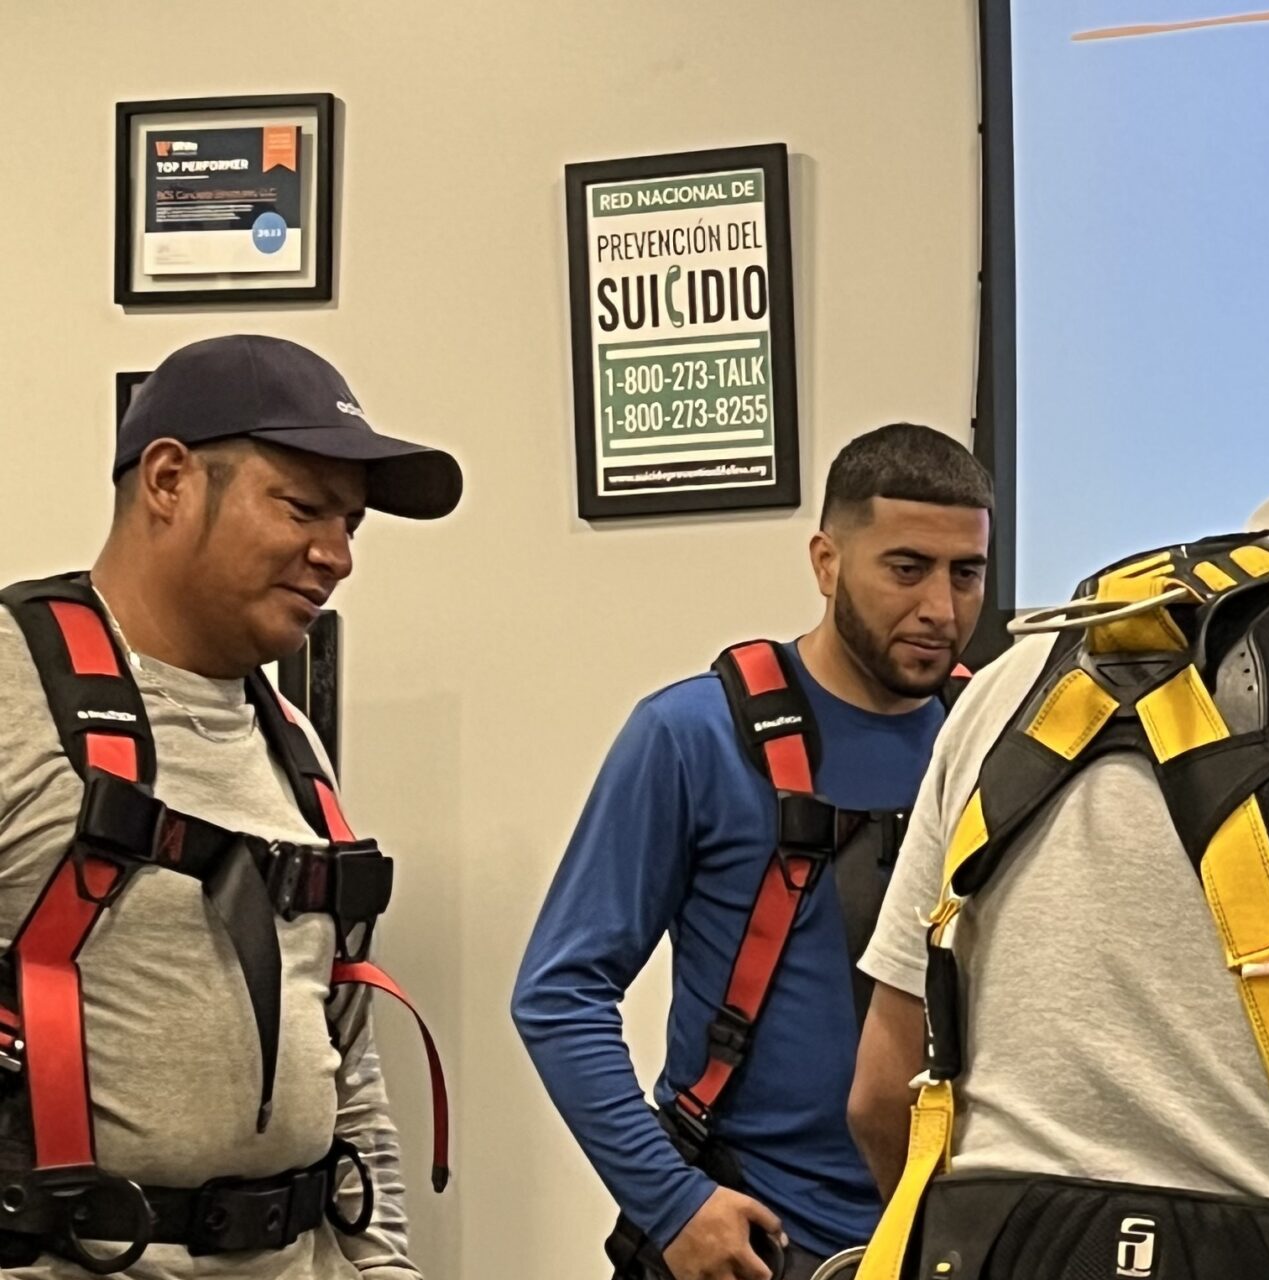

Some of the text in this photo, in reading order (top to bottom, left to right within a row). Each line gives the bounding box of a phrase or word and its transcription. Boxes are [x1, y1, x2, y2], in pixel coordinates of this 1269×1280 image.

[156, 158, 249, 173] TOP PERFORMER
[599, 180, 755, 211] RED NACIONAL DE
[597, 218, 762, 263] PREVENCIÓN DEL
[597, 264, 768, 332] SUICIDIO
[604, 355, 766, 397] 1-800-273-TALK
[604, 394, 768, 434] 1-800-273-8255
